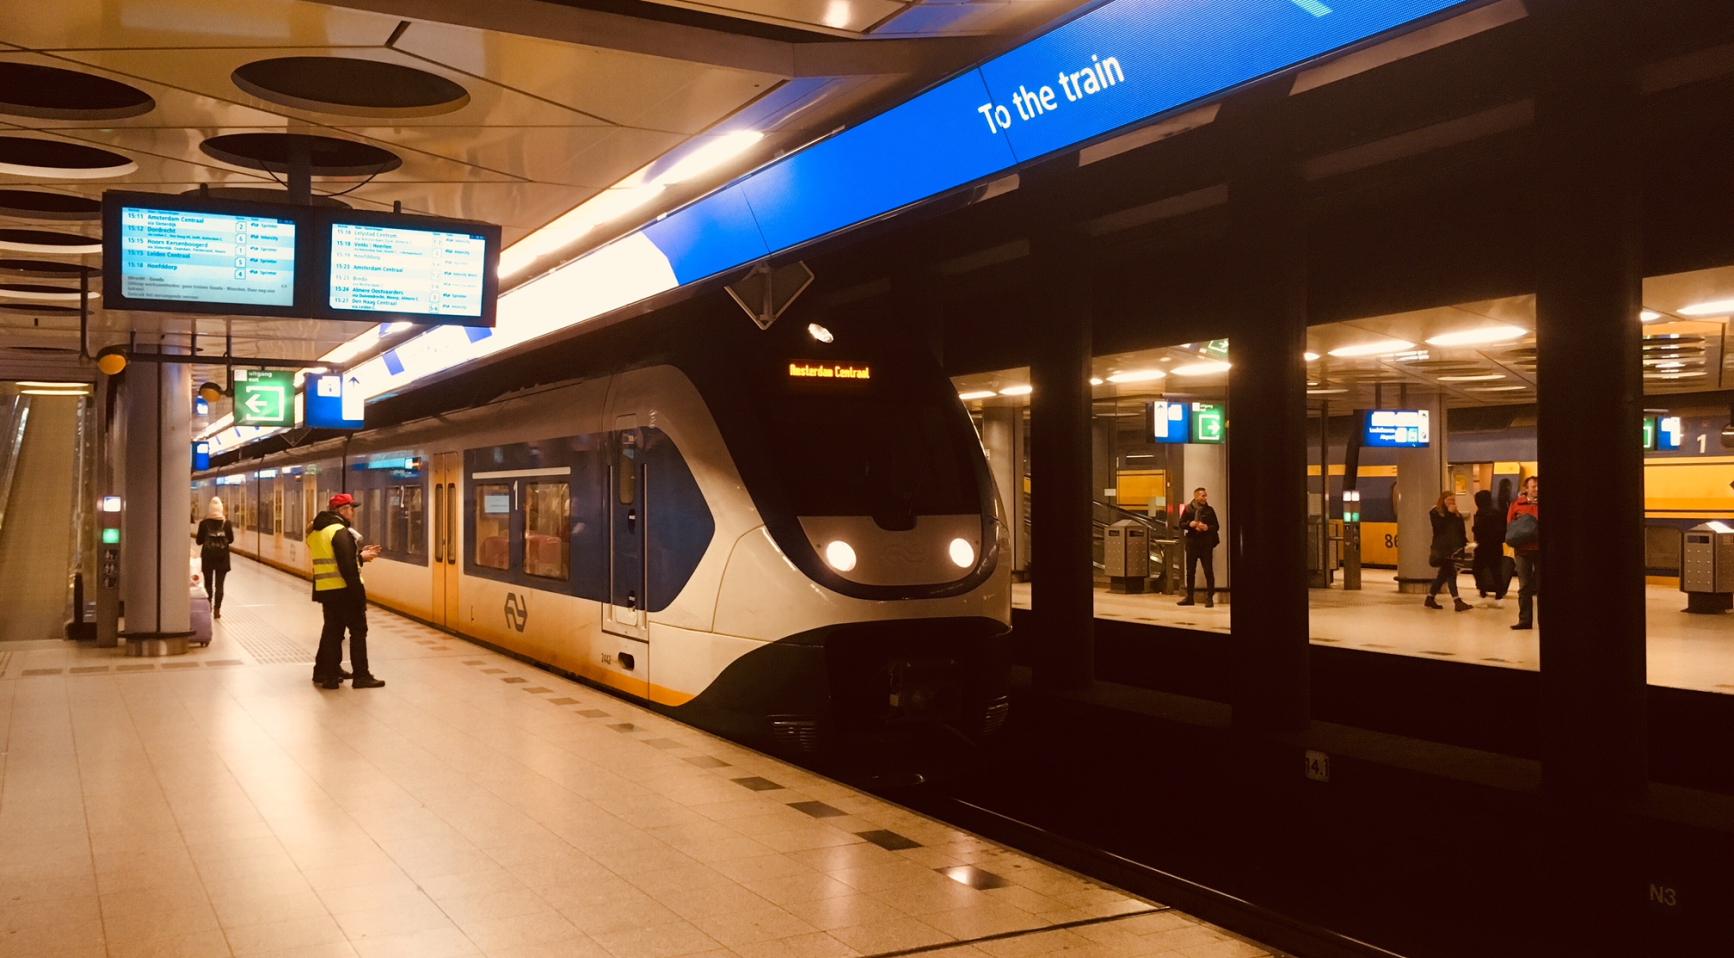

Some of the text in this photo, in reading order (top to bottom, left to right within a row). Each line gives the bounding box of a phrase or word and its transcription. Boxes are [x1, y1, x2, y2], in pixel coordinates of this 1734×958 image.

[977, 53, 1125, 134] To the train
[147, 214, 180, 222] Amsterdam
[147, 226, 176, 234] Dordrecht
[147, 263, 178, 271] Hoofddorp
[248, 371, 272, 379] uitgang
[789, 363, 870, 379] Amsterdam Centraal
[1696, 433, 1707, 454] 1
[513, 480, 519, 511] 1
[1305, 757, 1329, 777] 14.1
[1650, 884, 1676, 906] N3
